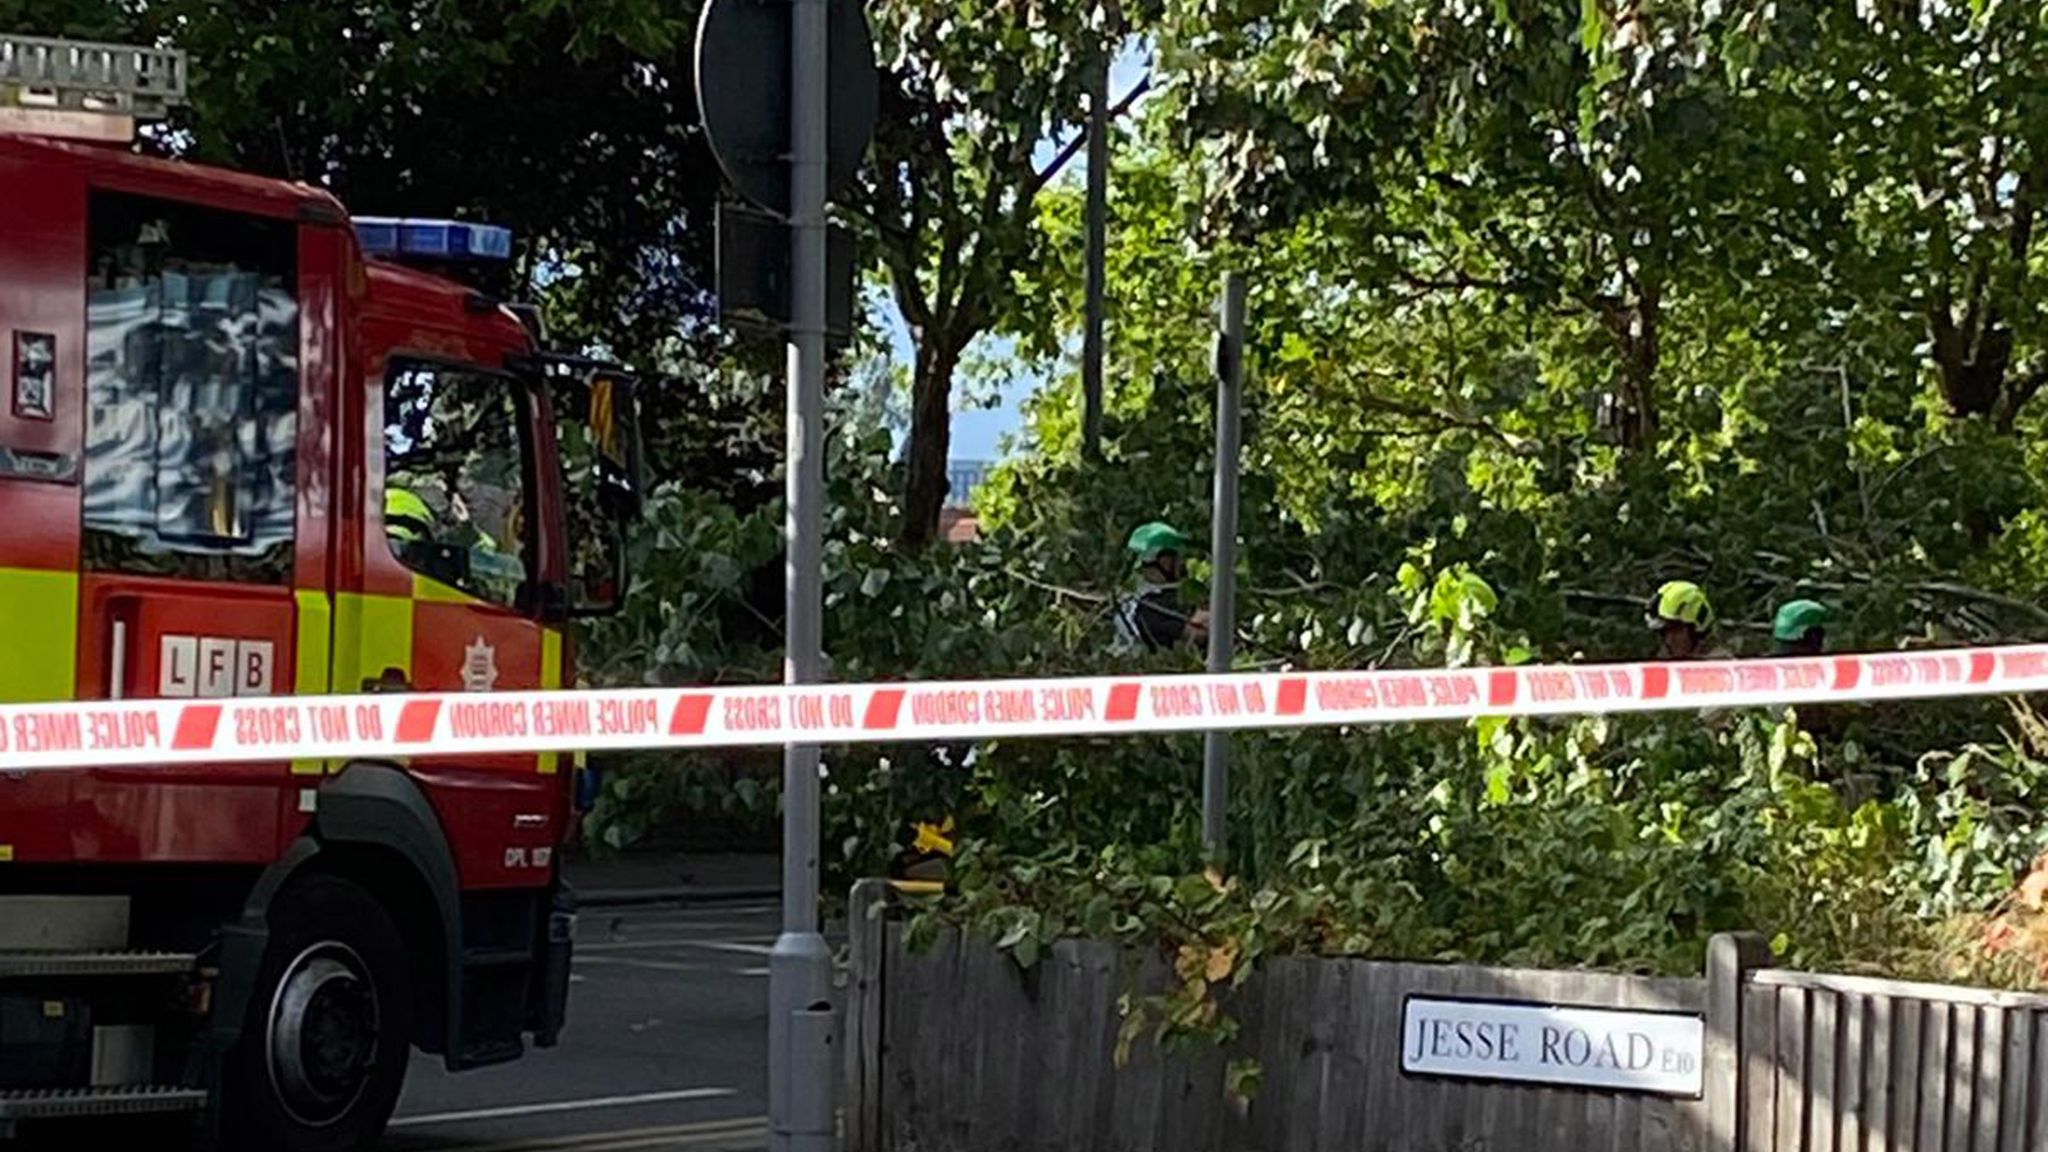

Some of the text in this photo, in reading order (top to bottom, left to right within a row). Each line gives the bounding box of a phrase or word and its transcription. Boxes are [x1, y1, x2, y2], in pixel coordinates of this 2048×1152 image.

[171, 646, 263, 688] LFB
[1409, 1018, 1695, 1075] JESSE ROAD E10
